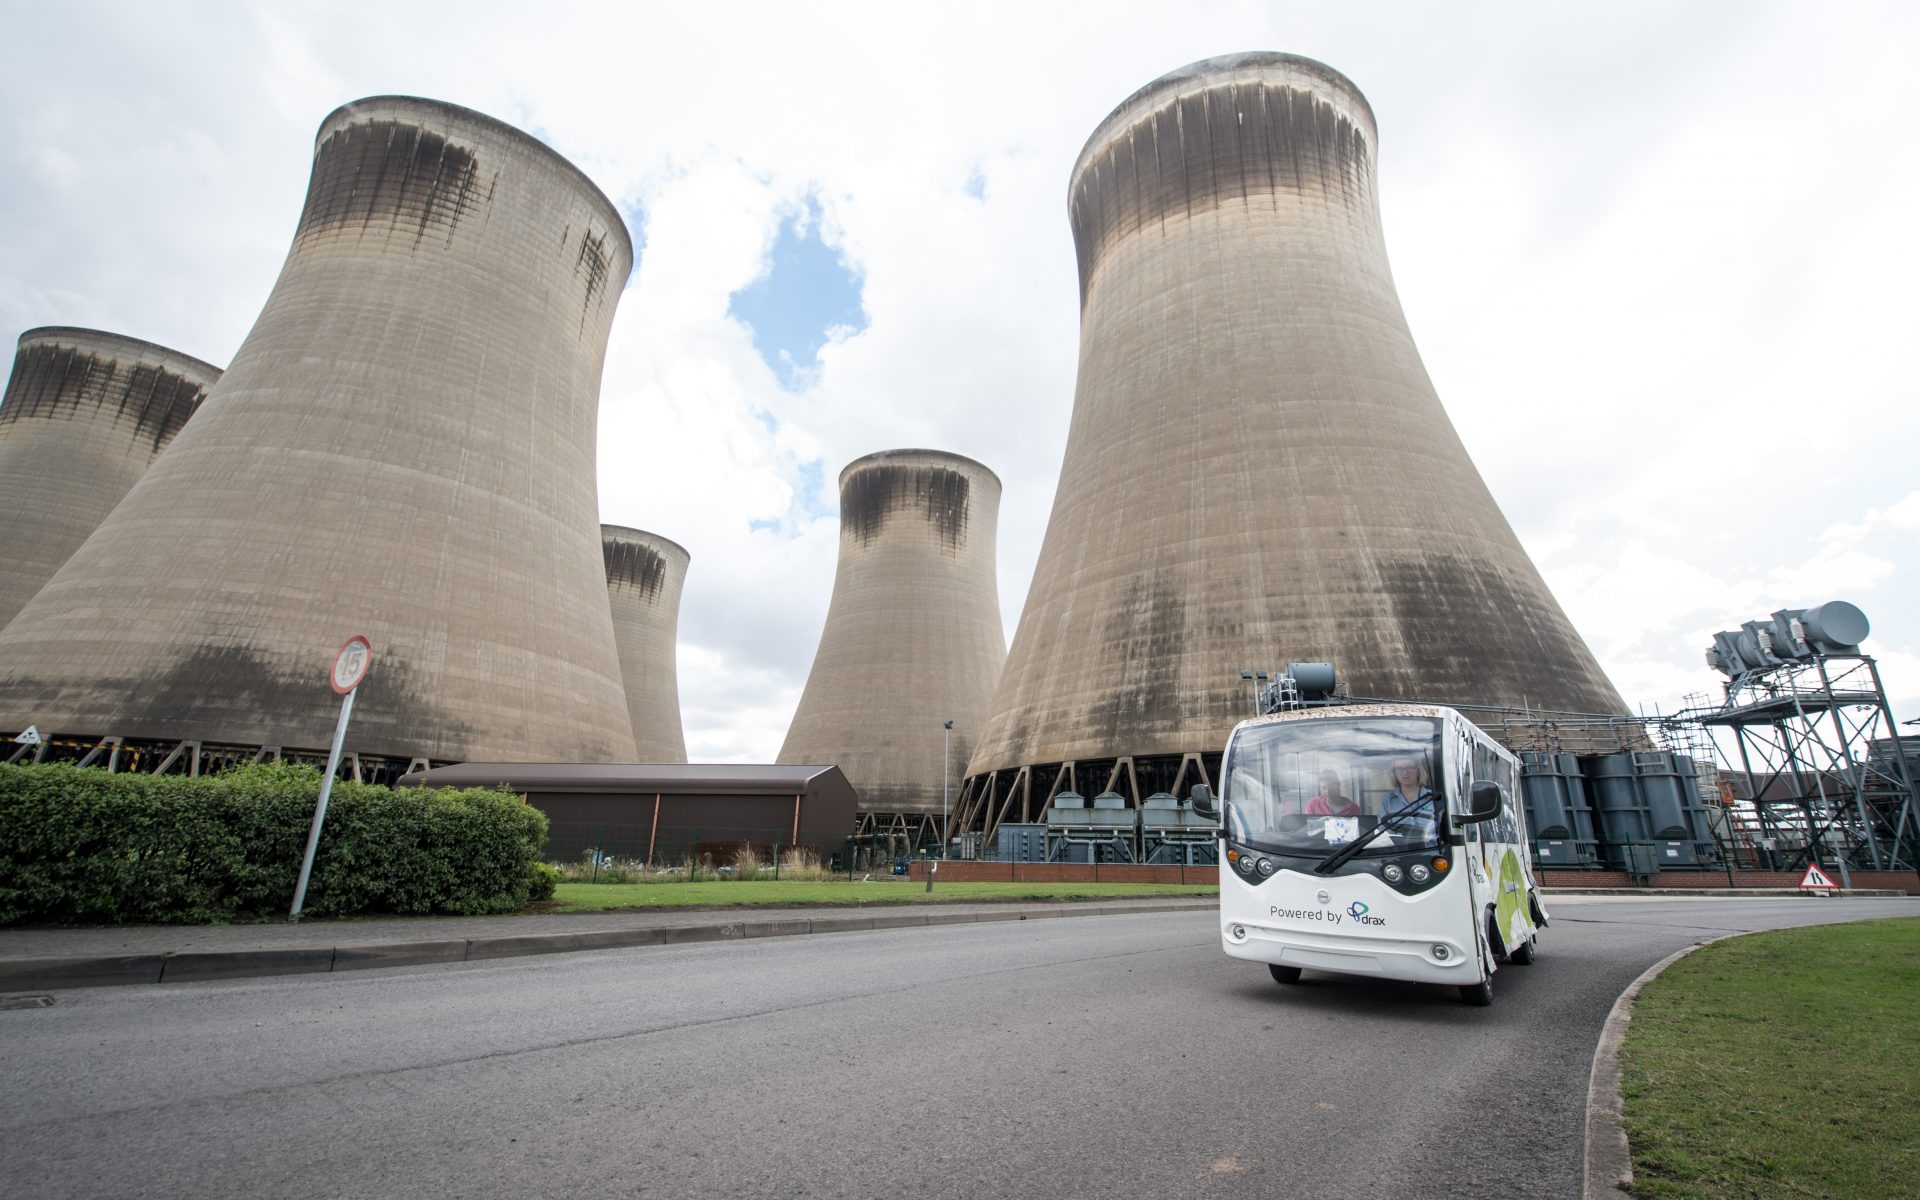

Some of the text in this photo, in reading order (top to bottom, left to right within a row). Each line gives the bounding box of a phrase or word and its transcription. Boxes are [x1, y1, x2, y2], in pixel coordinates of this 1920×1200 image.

[342, 653, 361, 676] 15
[1270, 906, 1386, 926] Powered by drax
